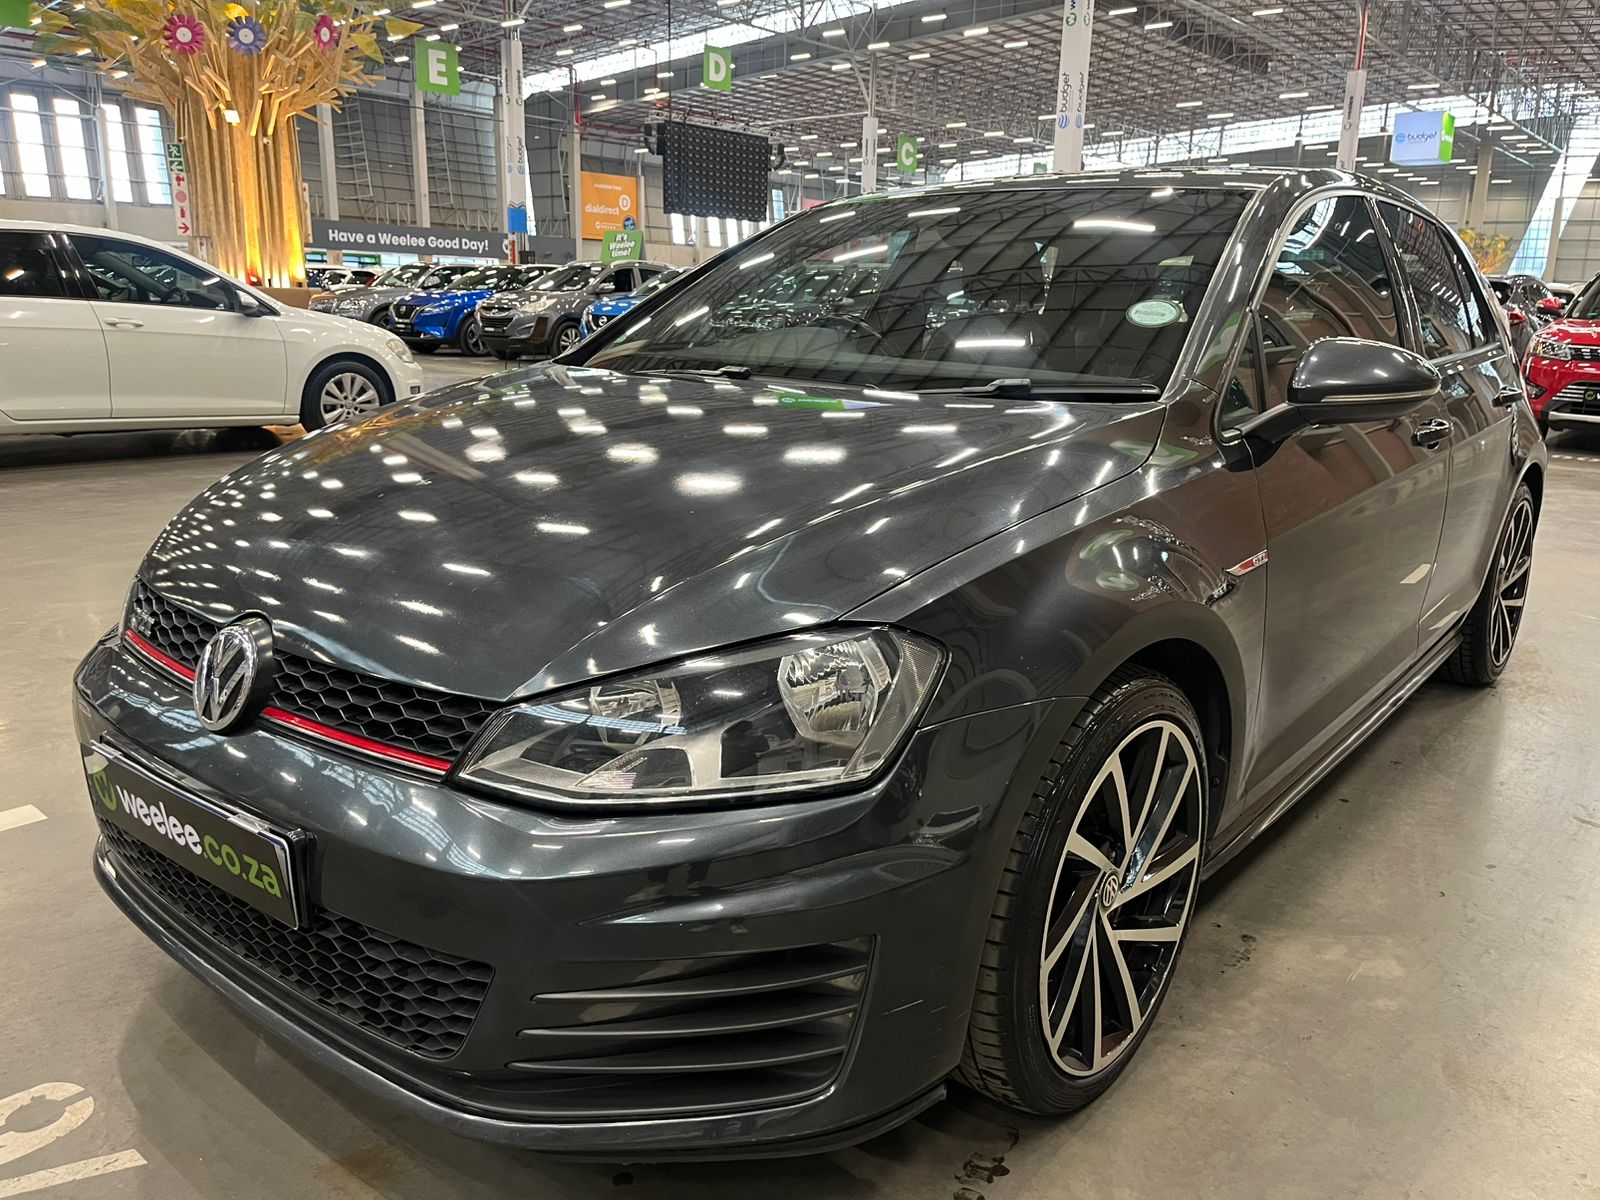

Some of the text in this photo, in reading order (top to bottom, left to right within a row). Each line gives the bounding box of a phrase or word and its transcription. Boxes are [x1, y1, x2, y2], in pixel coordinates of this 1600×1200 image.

[428, 49, 448, 86] E
[709, 52, 726, 82] D
[1060, 72, 1072, 113] budget
[1407, 131, 1437, 143] budget
[901, 142, 914, 166] C
[585, 203, 620, 216] dialdirect
[328, 229, 489, 254] Have a Weelee Good Day!
[609, 240, 635, 250] Weelee
[615, 233, 628, 242] It's
[611, 247, 631, 258] time!
[116, 785, 282, 898] weelee.co.za
